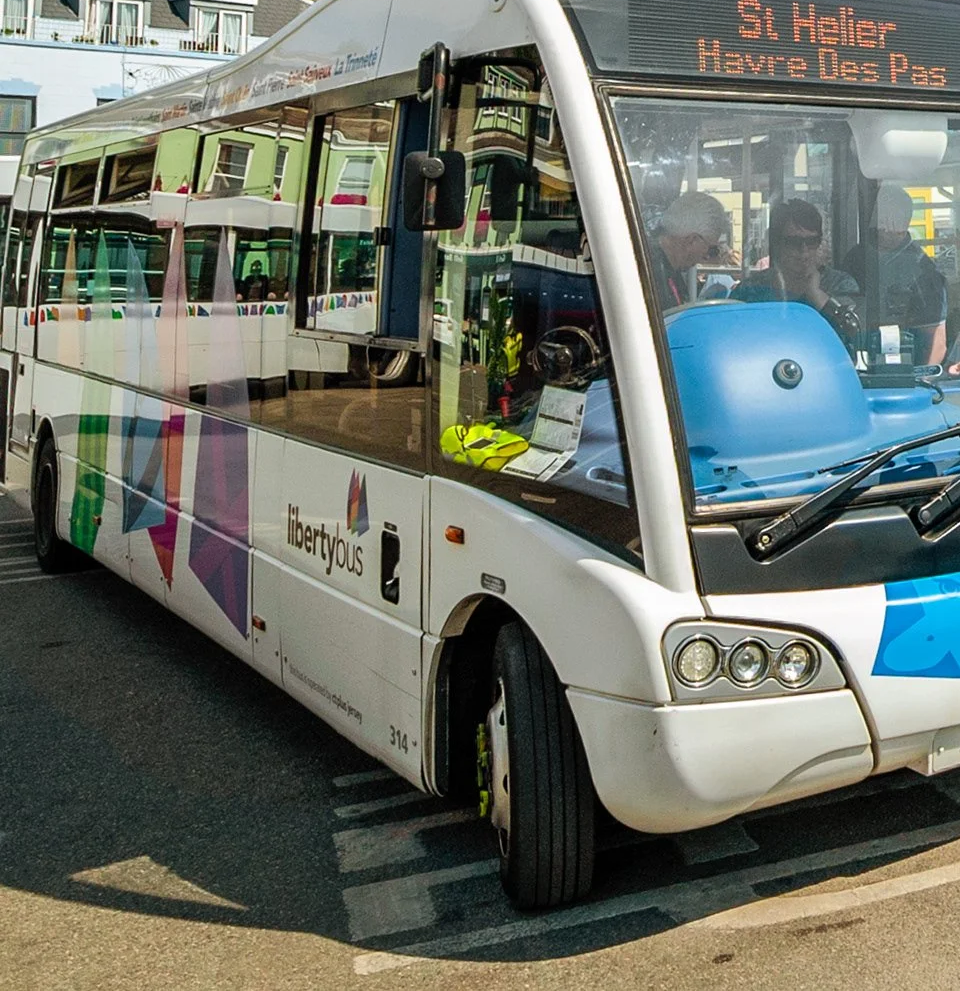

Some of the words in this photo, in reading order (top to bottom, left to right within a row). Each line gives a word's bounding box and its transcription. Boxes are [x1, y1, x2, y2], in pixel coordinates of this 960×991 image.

[793, 2, 896, 49] Helier
[334, 58, 344, 76] La
[697, 37, 808, 78] Havre
[818, 48, 880, 83] Des
[889, 52, 947, 88] Pas
[287, 503, 364, 577] libertybus
[390, 725, 409, 755] 314
